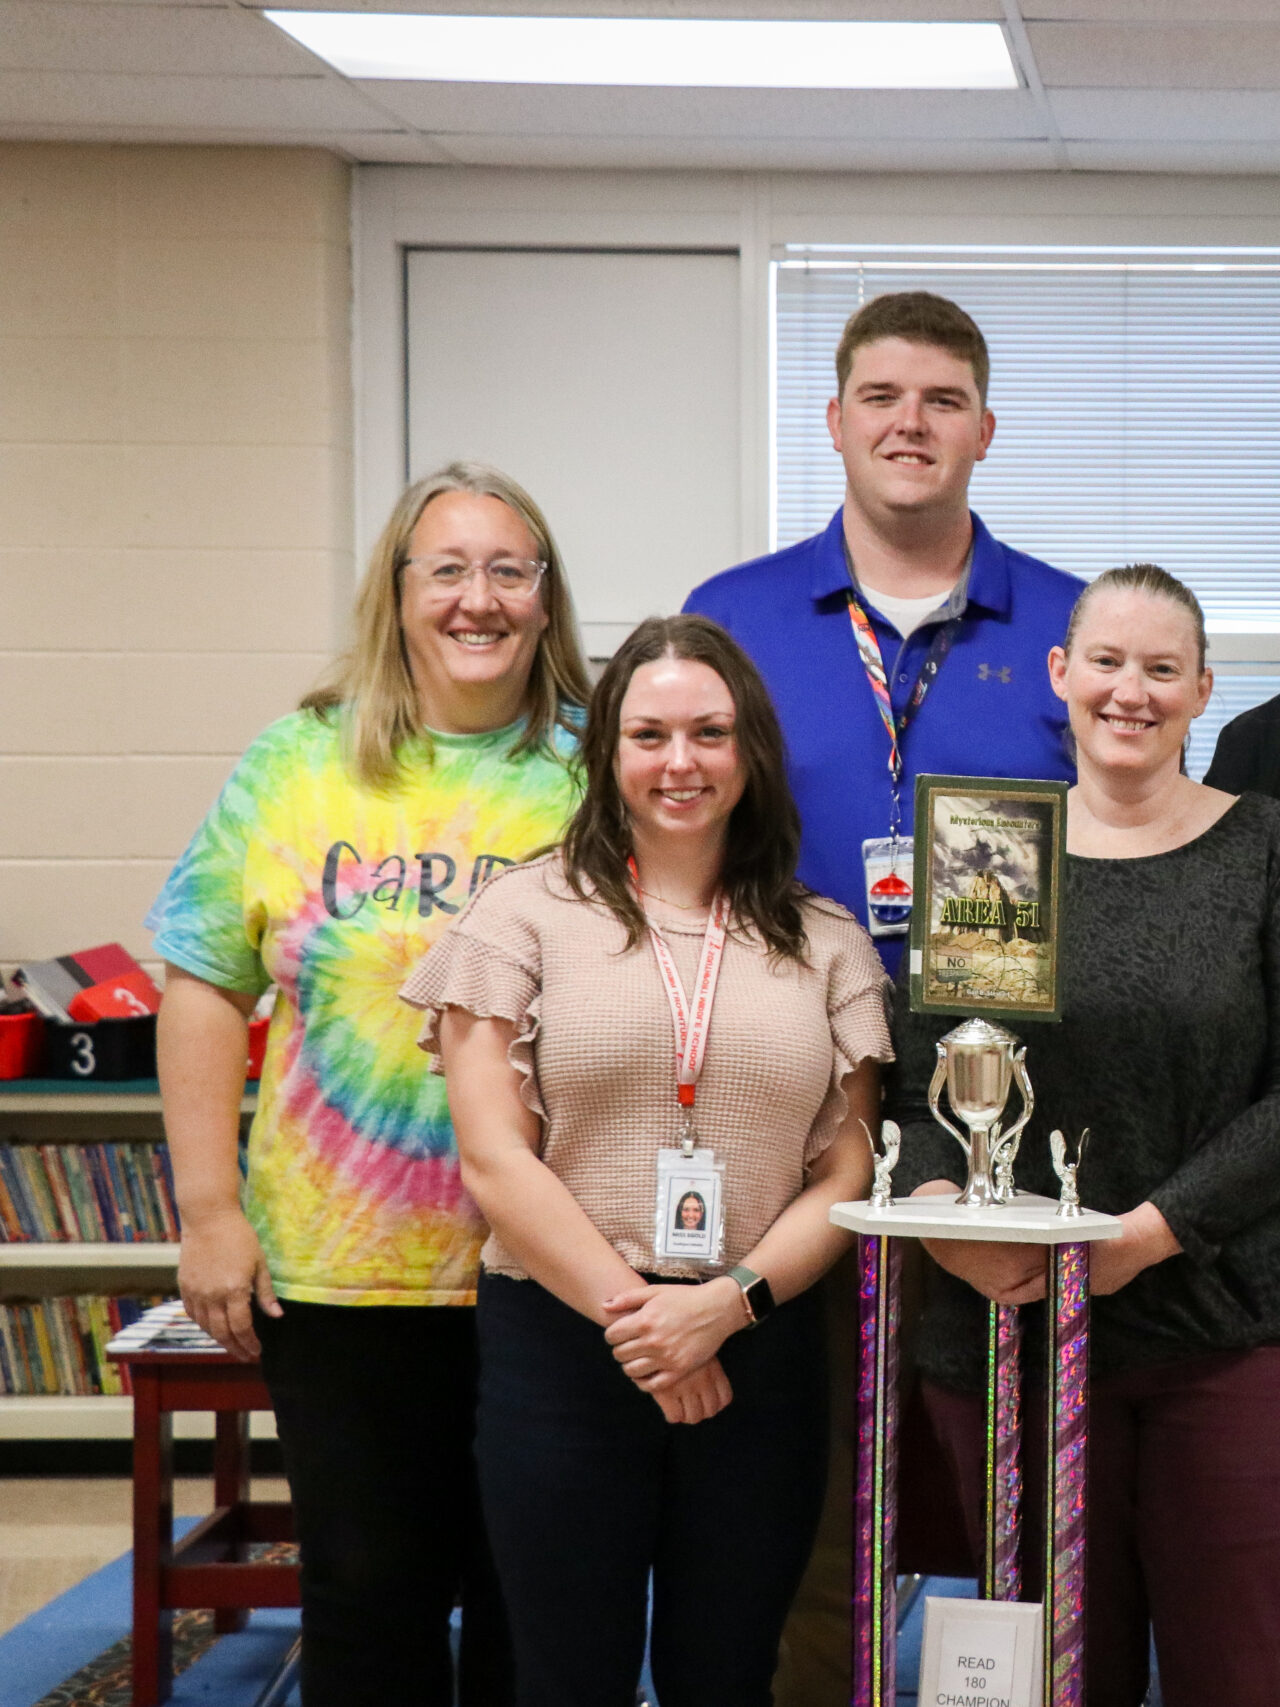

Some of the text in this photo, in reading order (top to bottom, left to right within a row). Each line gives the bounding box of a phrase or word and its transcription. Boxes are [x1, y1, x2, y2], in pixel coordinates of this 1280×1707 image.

[941, 897, 1040, 927] AREA 51
[947, 957, 966, 968] NO
[71, 1032, 96, 1075] 3
[957, 1656, 995, 1670] READ
[965, 1676, 986, 1689] 180
